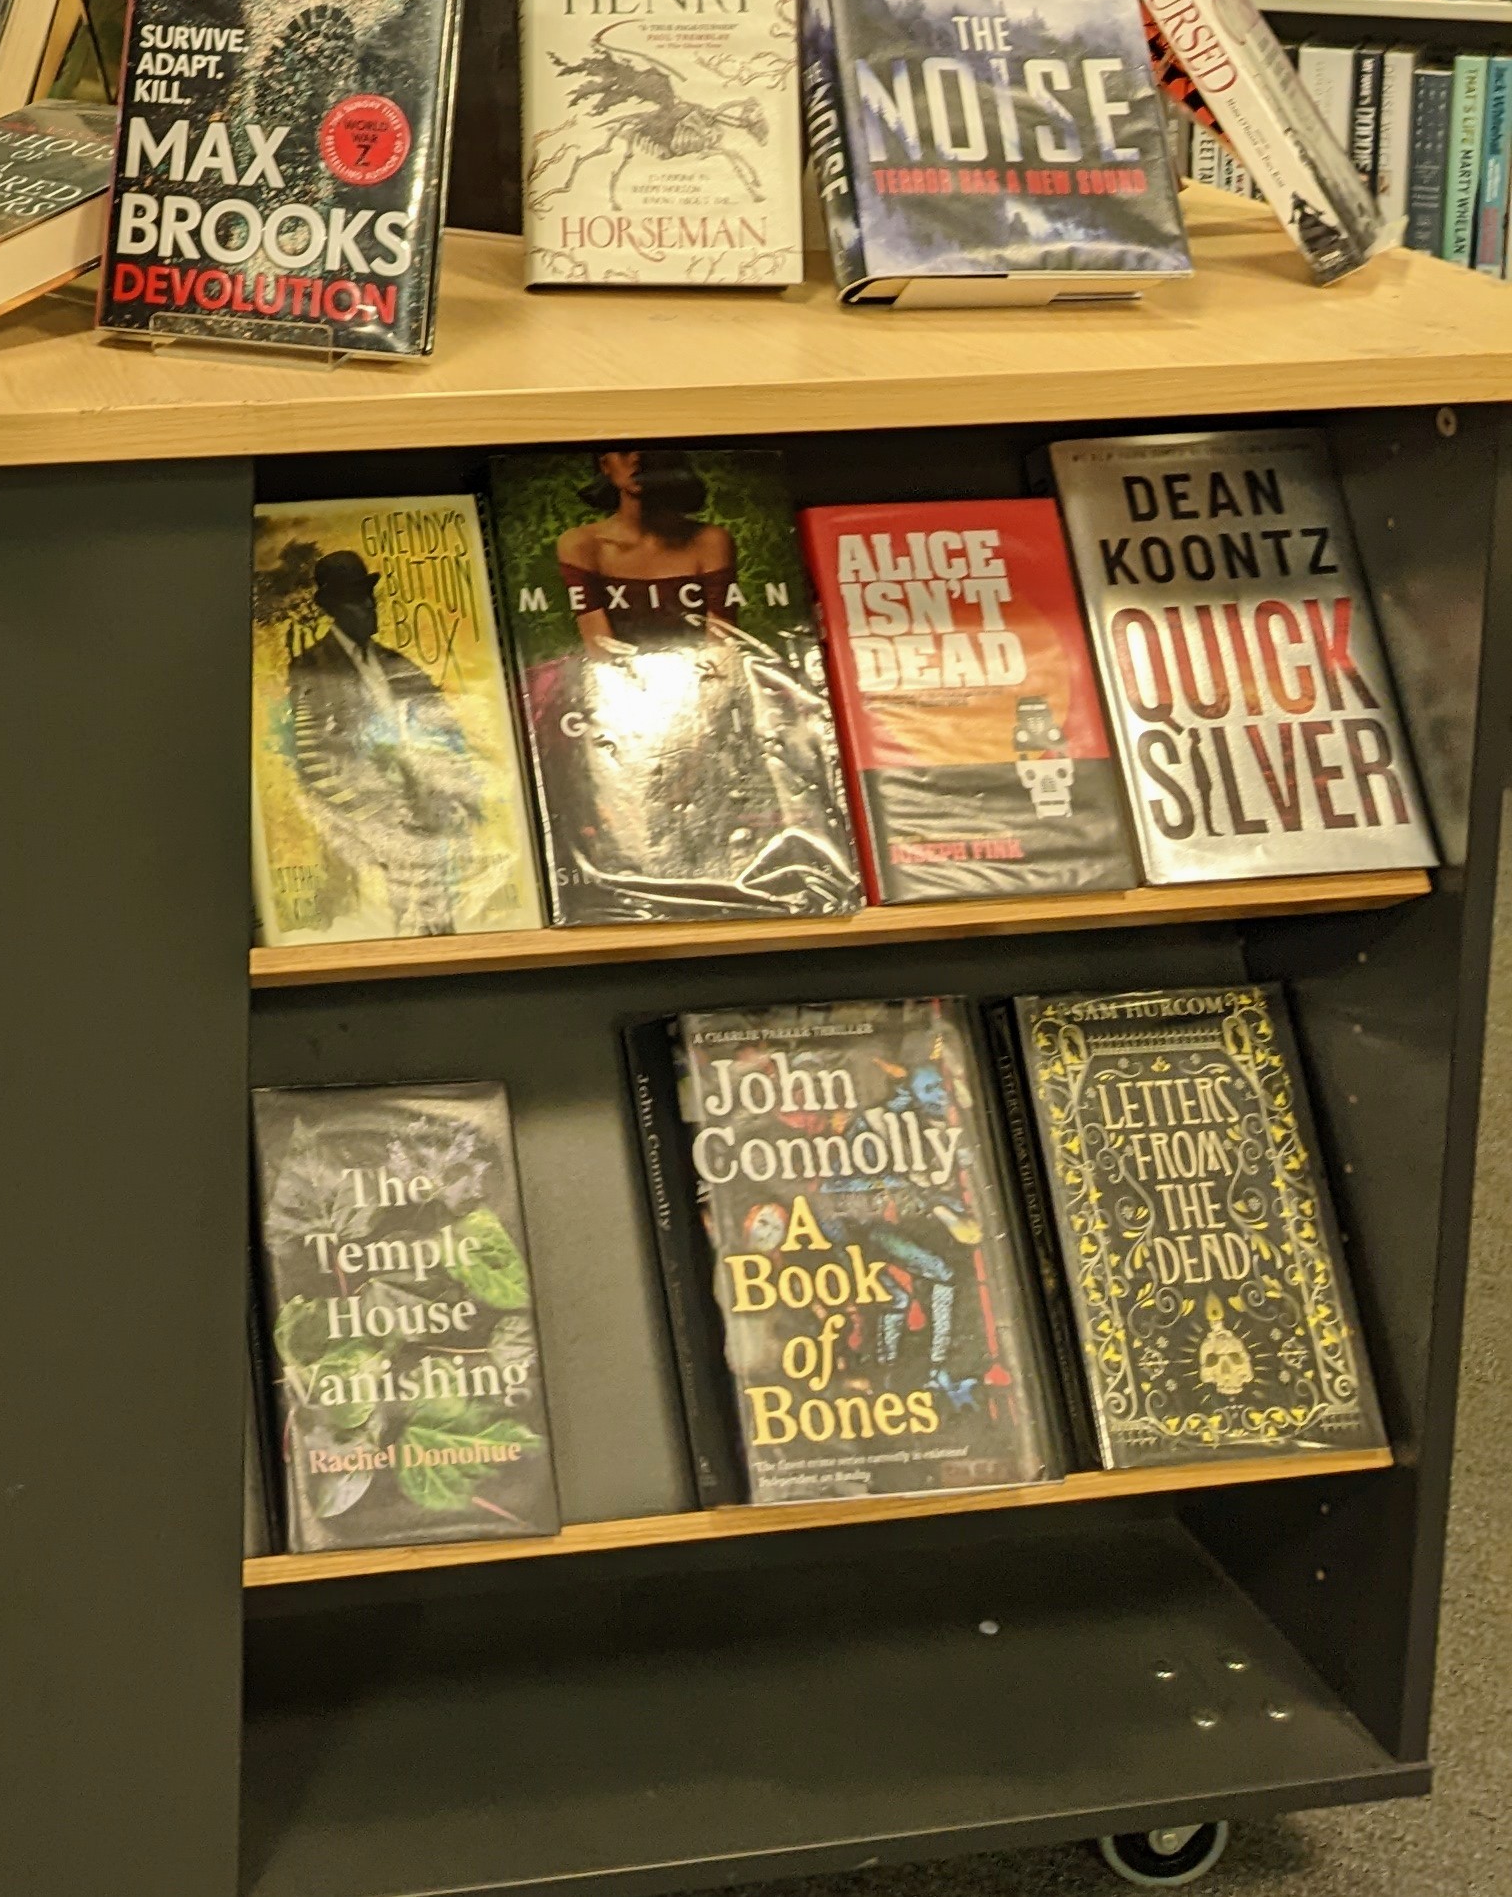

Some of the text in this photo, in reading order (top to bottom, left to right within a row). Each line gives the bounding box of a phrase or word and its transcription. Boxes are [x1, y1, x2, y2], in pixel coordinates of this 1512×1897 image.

[139, 24, 250, 54] SURVIVE.
[952, 15, 1012, 52] THE
[134, 79, 192, 105] KILL.
[136, 54, 225, 82] ADAPT.
[345, 119, 389, 132] WORLD
[855, 57, 1141, 163] NOISE
[1489, 66, 1508, 156] Jack Whitehall
[124, 116, 290, 189] MAX
[355, 144, 370, 166] Z
[1453, 67, 1478, 255] THAT'S LIFE MARTY WHELAN
[872, 168, 1148, 196] TERROR HAS A NEW SOUND
[116, 193, 413, 277] BROOKS
[560, 215, 767, 262] HORSEMAN
[113, 263, 398, 325] DEVOLUTION
[1122, 467, 1285, 523] DEAN
[360, 509, 467, 557] GWENDY'S
[837, 529, 1007, 584] ALICE
[1099, 527, 1338, 586] KOONTZ
[382, 555, 480, 643] BUTTON
[518, 582, 789, 612] MEXICAN
[840, 576, 1012, 637] ISN'T
[394, 600, 466, 693] BOX
[849, 631, 1027, 693] DEAD
[1110, 596, 1381, 736] QUICK
[1136, 717, 1410, 841] SILVER
[971, 838, 1025, 861] FINK
[1070, 995, 1226, 1023] SAM HURCOM
[705, 1050, 858, 1117] John
[1096, 1076, 1241, 1130] LETTERS
[634, 1072, 674, 1232] John Connolly
[692, 1107, 962, 1186] Connolly
[1132, 1129, 1233, 1181] FROM
[342, 1166, 434, 1209] The
[1156, 1180, 1226, 1232] THE
[780, 1195, 832, 1252] A
[303, 1225, 482, 1282] Temple
[724, 1244, 892, 1314] Book
[1154, 1233, 1252, 1285] DEAD
[326, 1295, 477, 1340] House
[782, 1313, 845, 1392] of
[284, 1356, 531, 1408] Vanishing
[745, 1386, 939, 1446] Bones
[309, 1438, 522, 1476] Rachel Donohue
